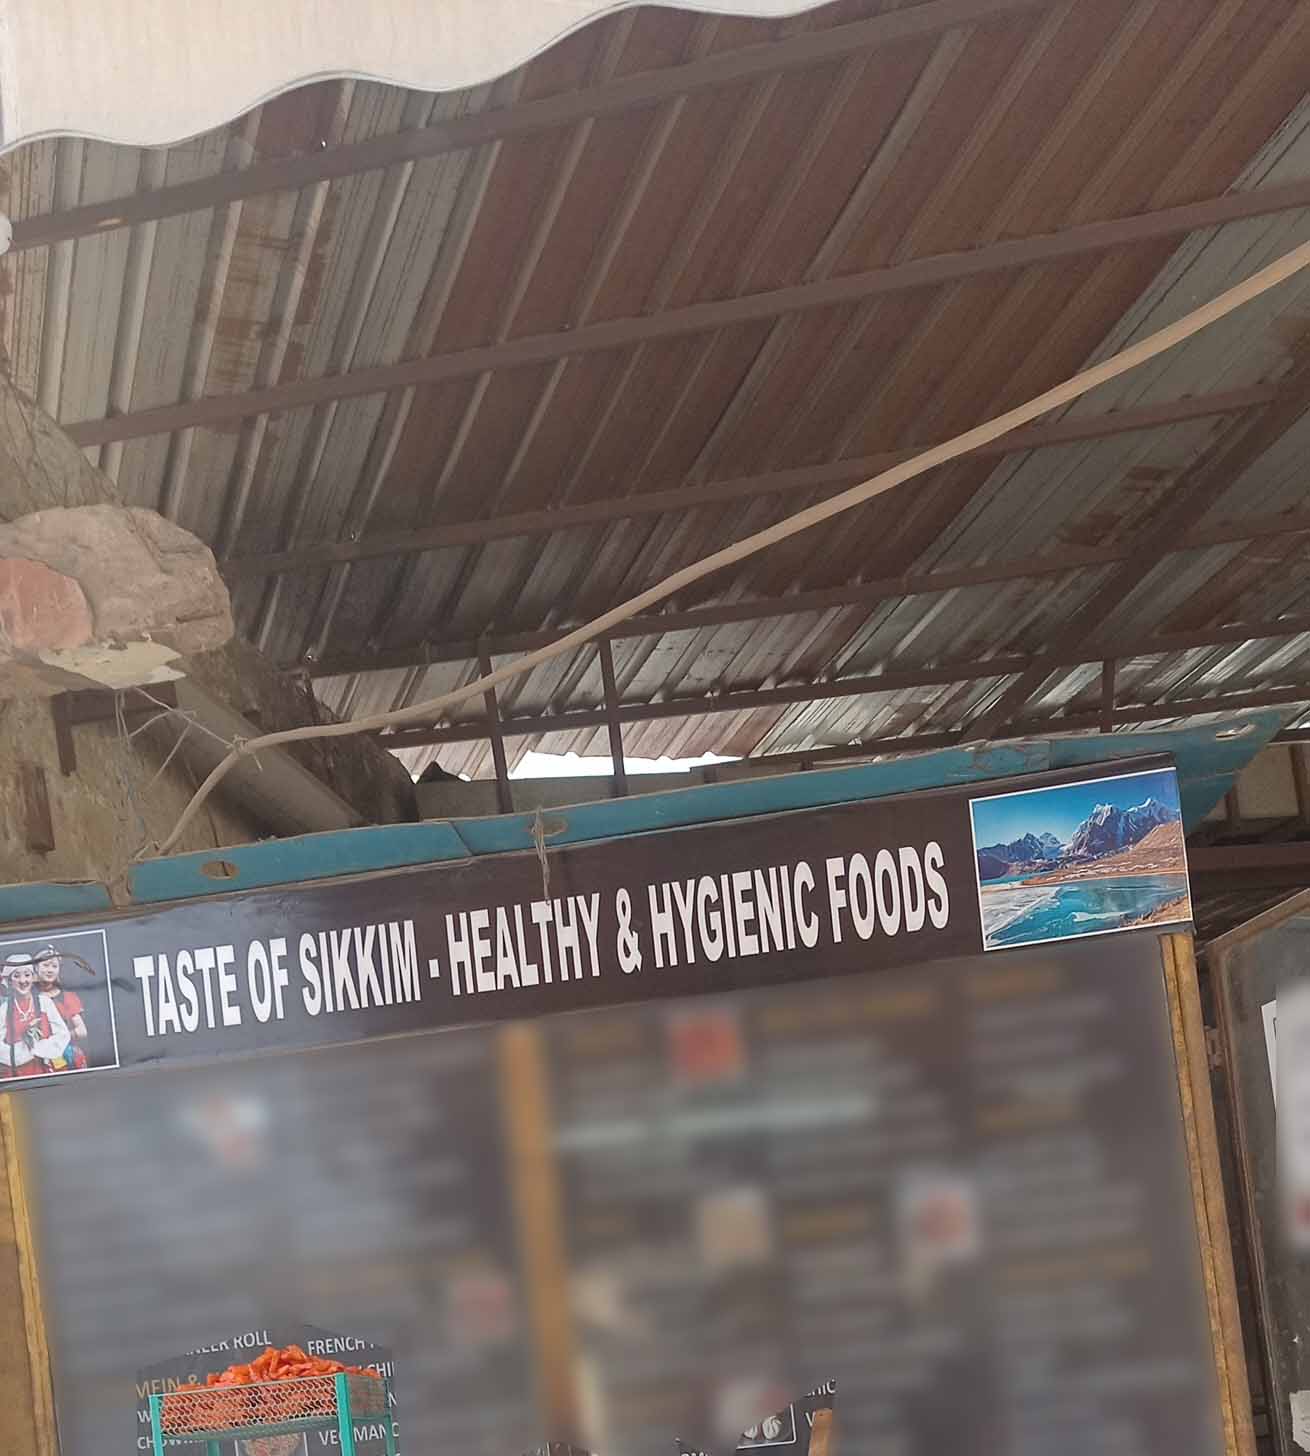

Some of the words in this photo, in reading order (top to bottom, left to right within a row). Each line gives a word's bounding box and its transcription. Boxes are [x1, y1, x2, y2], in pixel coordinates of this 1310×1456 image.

[133, 944, 243, 1037] TASTE
[246, 937, 289, 1024] OF
[299, 919, 421, 1017] SIKKIM
[445, 892, 600, 997] HEALTHY
[615, 887, 642, 974] &
[648, 861, 819, 969] HYGIENIC
[825, 840, 950, 944] FOODS
[233, 1329, 272, 1350] ROLL
[306, 1336, 365, 1356] FRENCH
